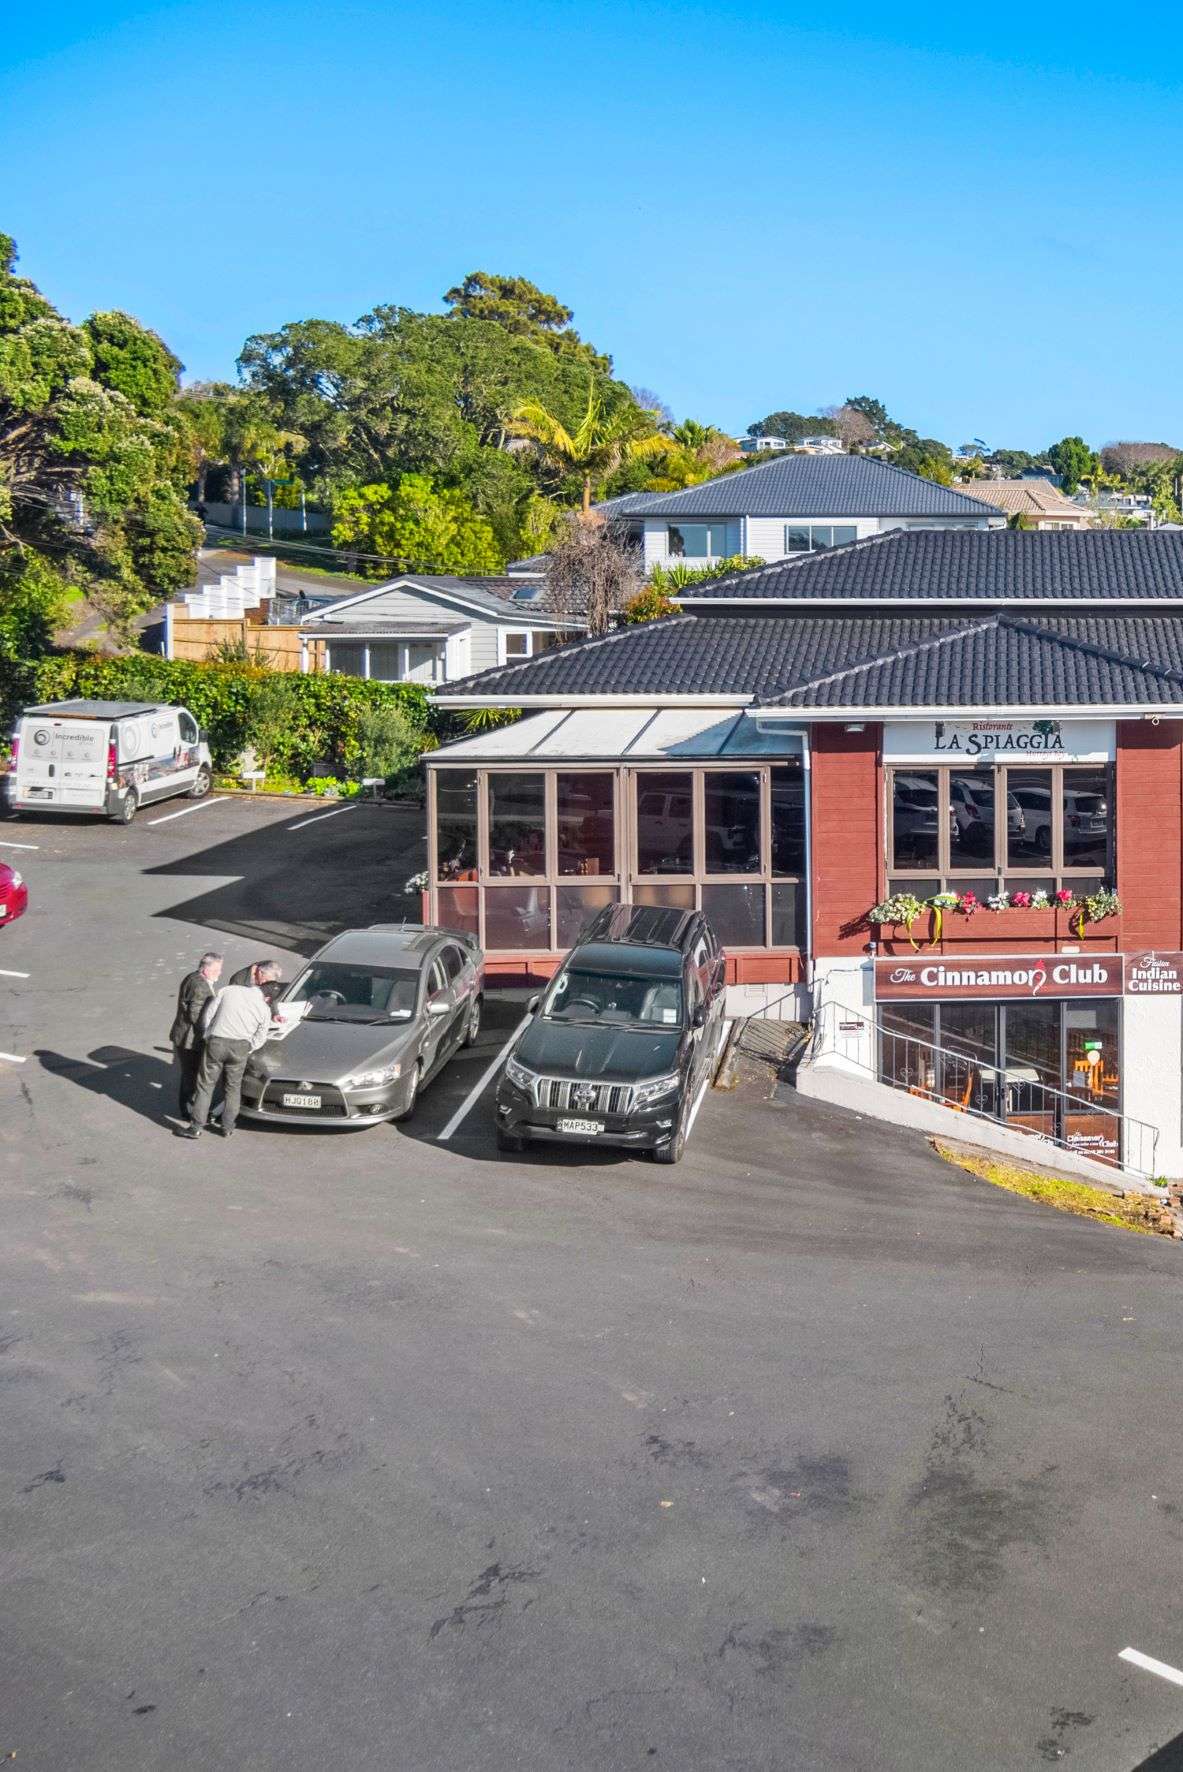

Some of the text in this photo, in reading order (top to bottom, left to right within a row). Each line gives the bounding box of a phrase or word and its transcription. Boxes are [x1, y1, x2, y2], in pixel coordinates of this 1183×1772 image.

[972, 722, 1013, 731] Ristorante
[934, 734, 1065, 755] LA SPIAGGIA
[1132, 967, 1177, 979] Indian
[890, 965, 1108, 995] The Cinnamon Club
[1130, 979, 1181, 992] Cuisine
